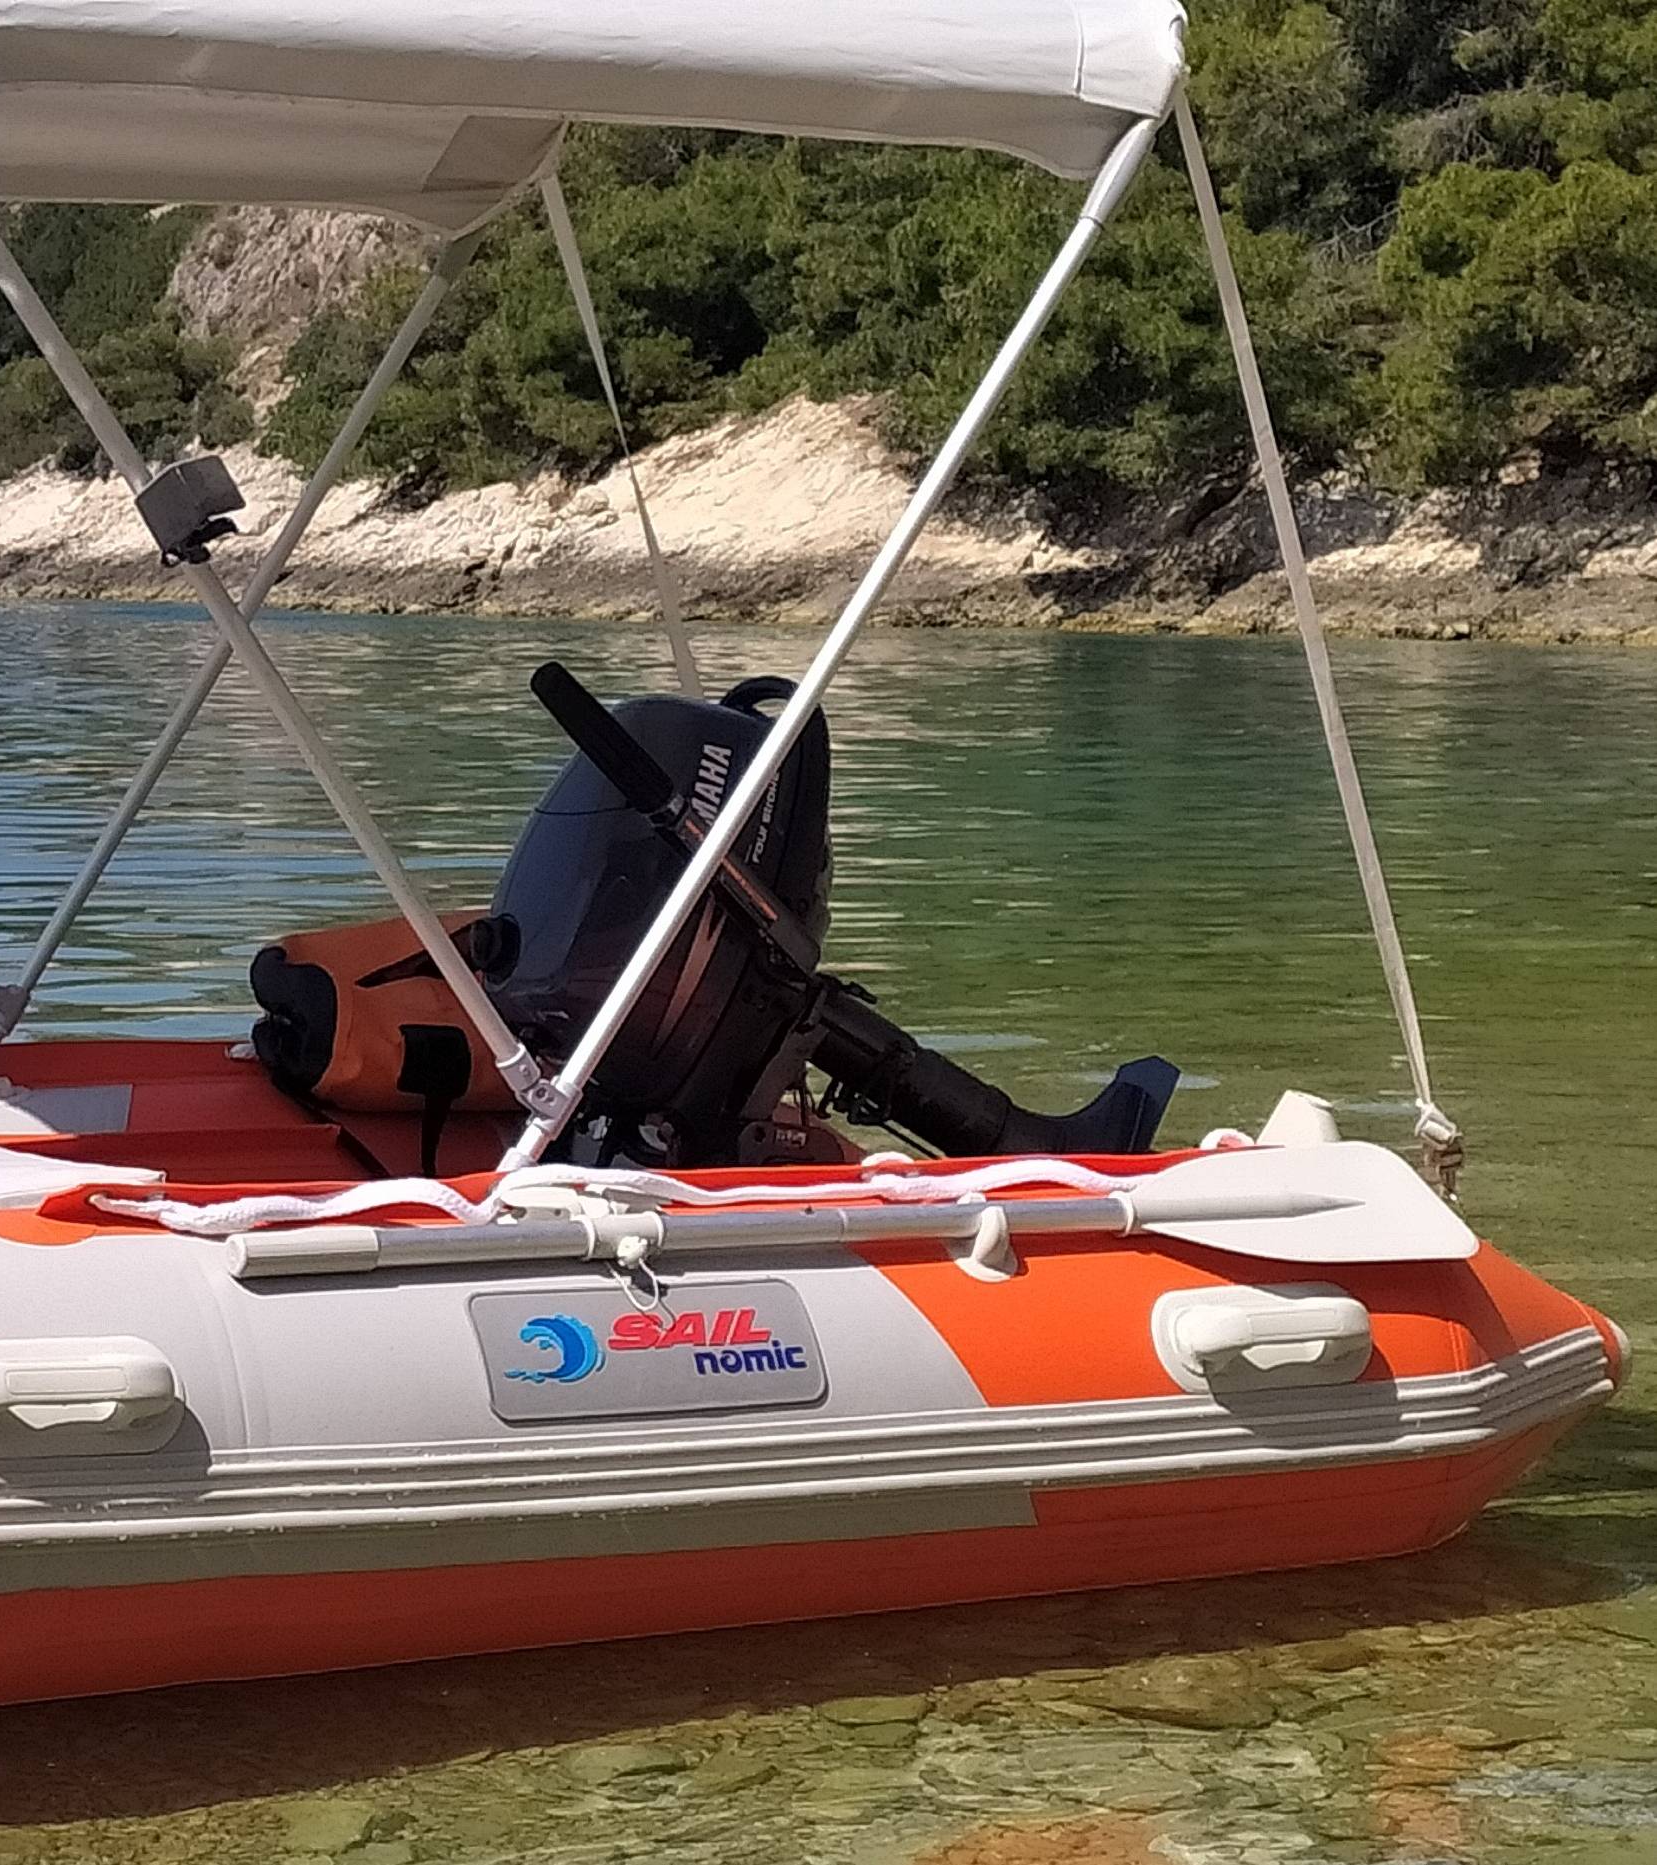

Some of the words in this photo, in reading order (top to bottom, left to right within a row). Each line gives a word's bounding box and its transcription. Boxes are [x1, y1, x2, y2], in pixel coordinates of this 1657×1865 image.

[689, 743, 733, 827] MAHA
[608, 1308, 771, 1350] SAIL
[694, 1340, 807, 1376] nomic
